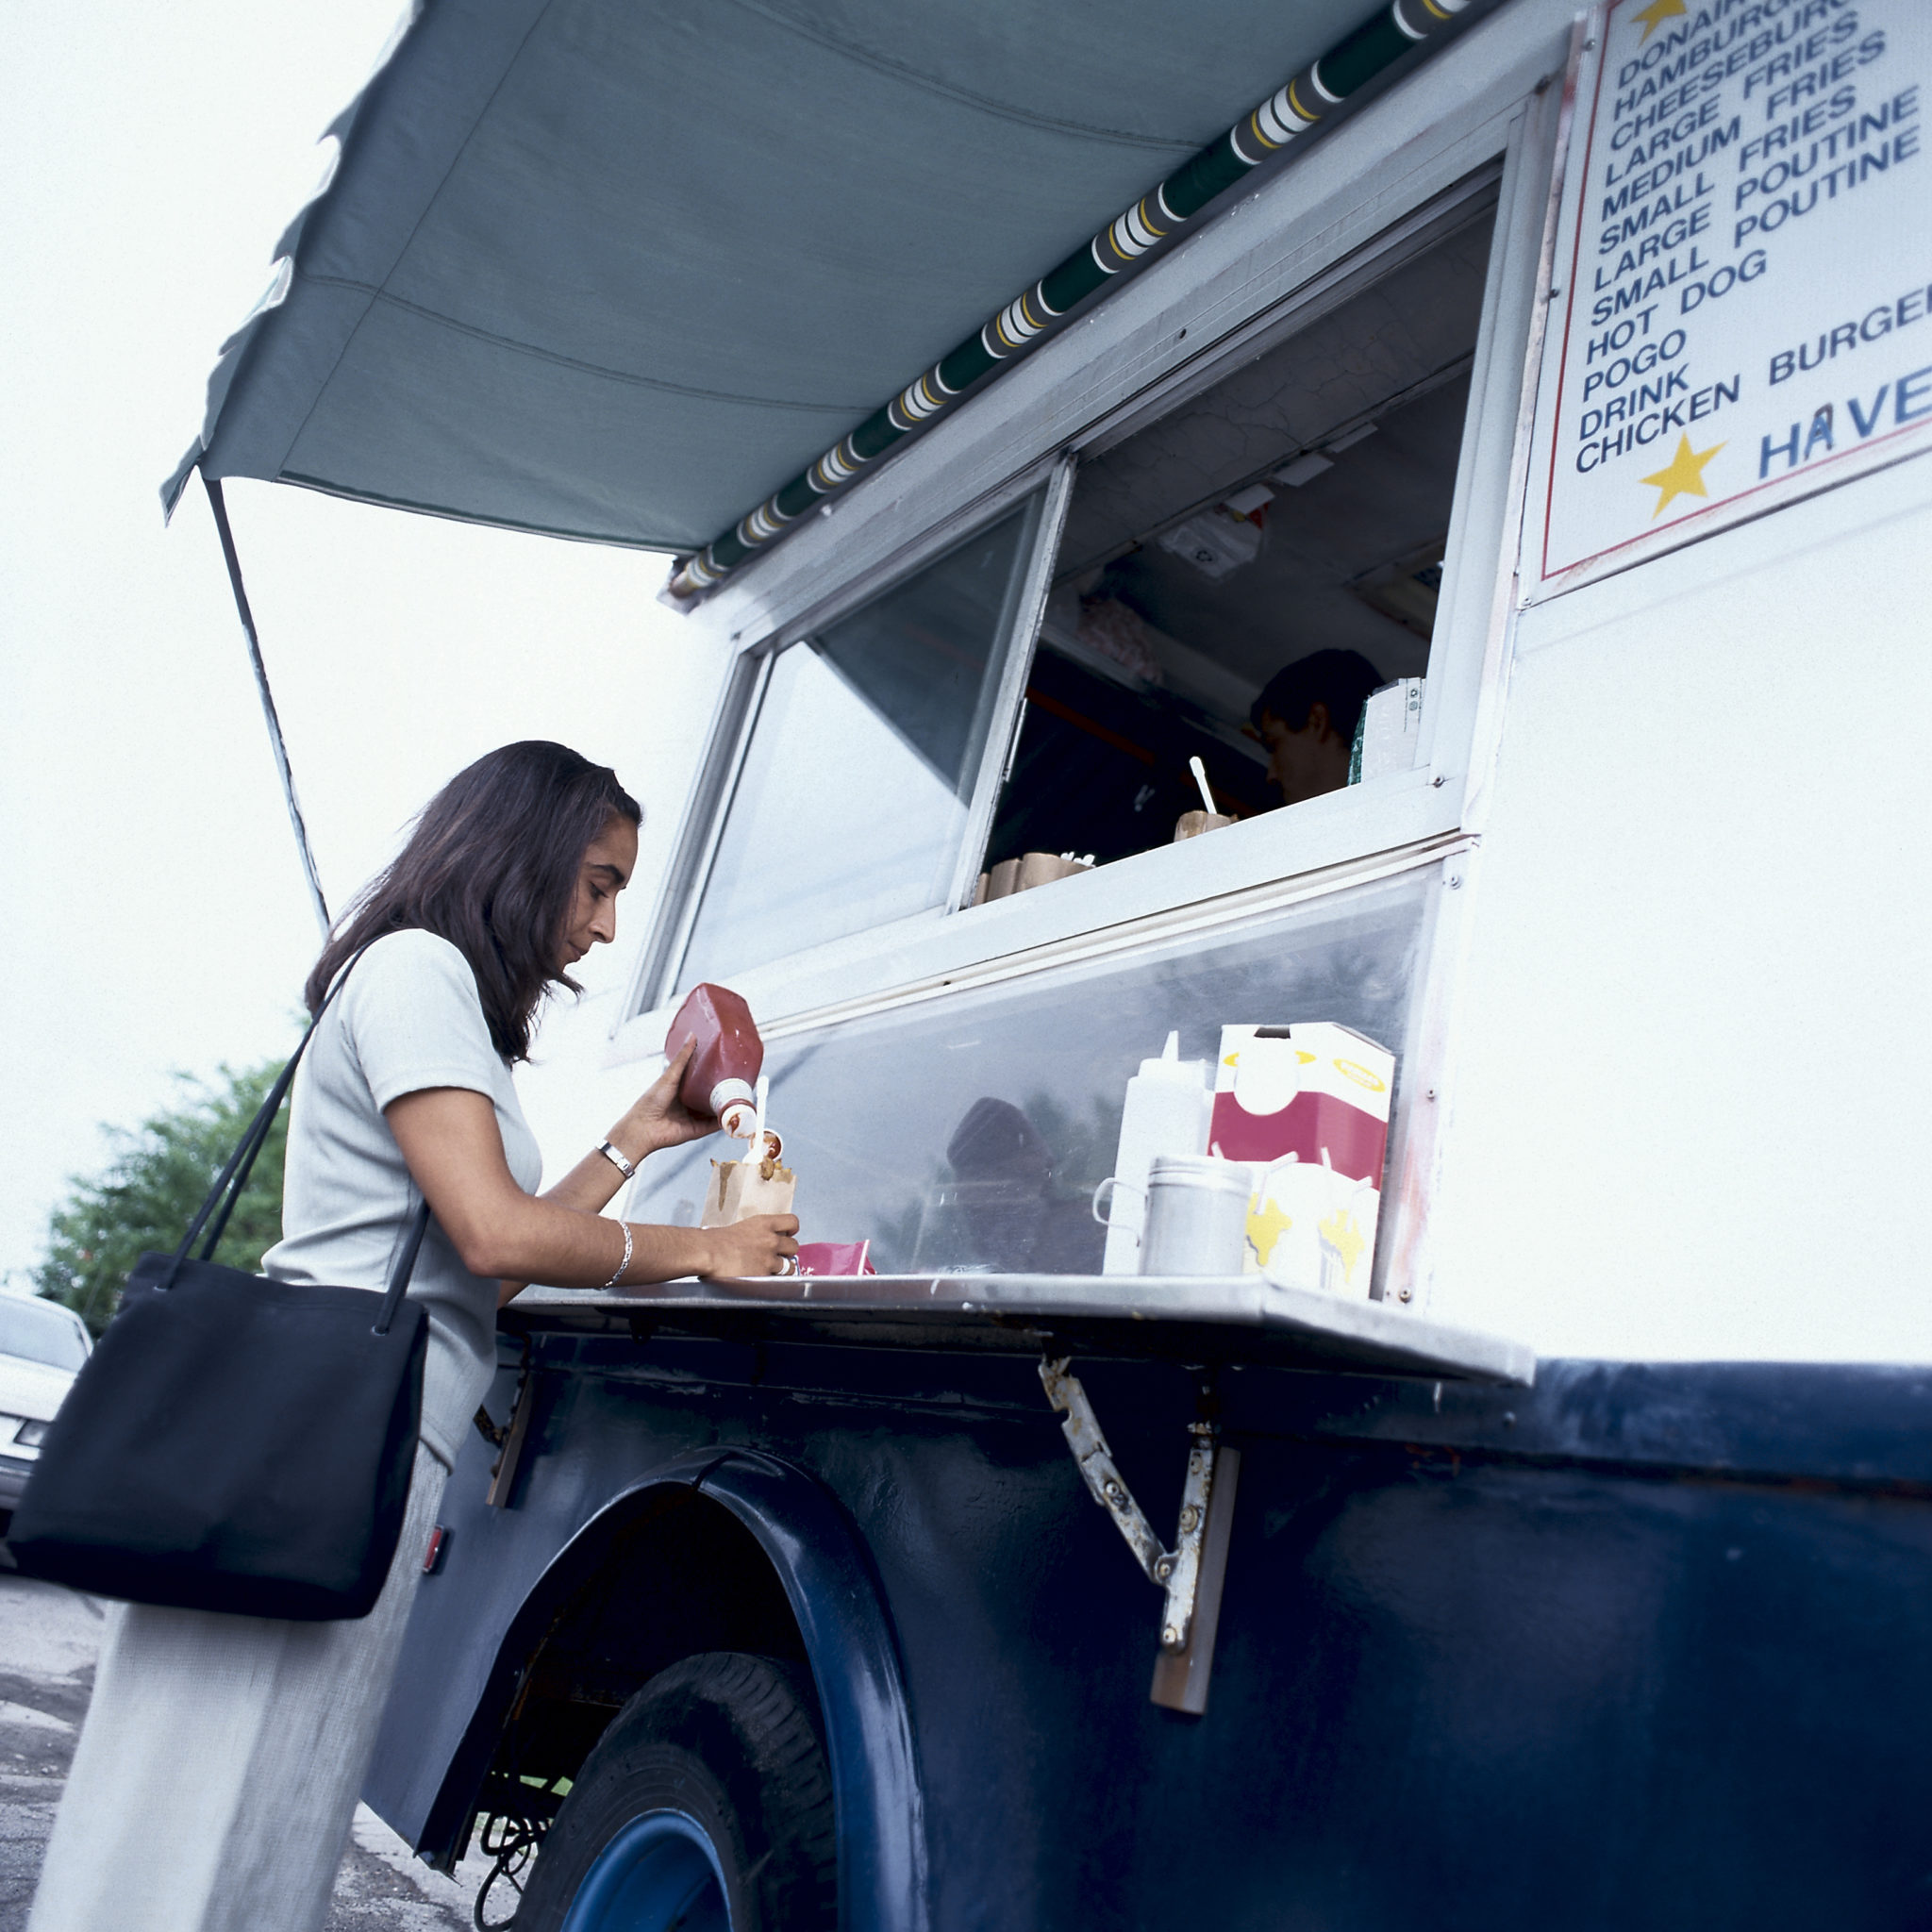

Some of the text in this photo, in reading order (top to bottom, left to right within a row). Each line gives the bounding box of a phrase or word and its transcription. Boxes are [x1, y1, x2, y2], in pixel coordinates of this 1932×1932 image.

[1599, 85, 1857, 255] SMALL FRIES
[1601, 29, 1887, 222] MEDIUM FRIES
[1606, 10, 1859, 188] LARGE FRIES
[1591, 125, 1922, 326] SMALL POUTINE
[1594, 84, 1921, 291] LARGE POUTINE
[1575, 282, 1932, 474] CHICKEN BURGE
[1582, 328, 1687, 402] POGO
[1586, 249, 1767, 365] HOT DOG
[1579, 363, 1690, 441] DRINK
[1758, 364, 1932, 479] HAVE
